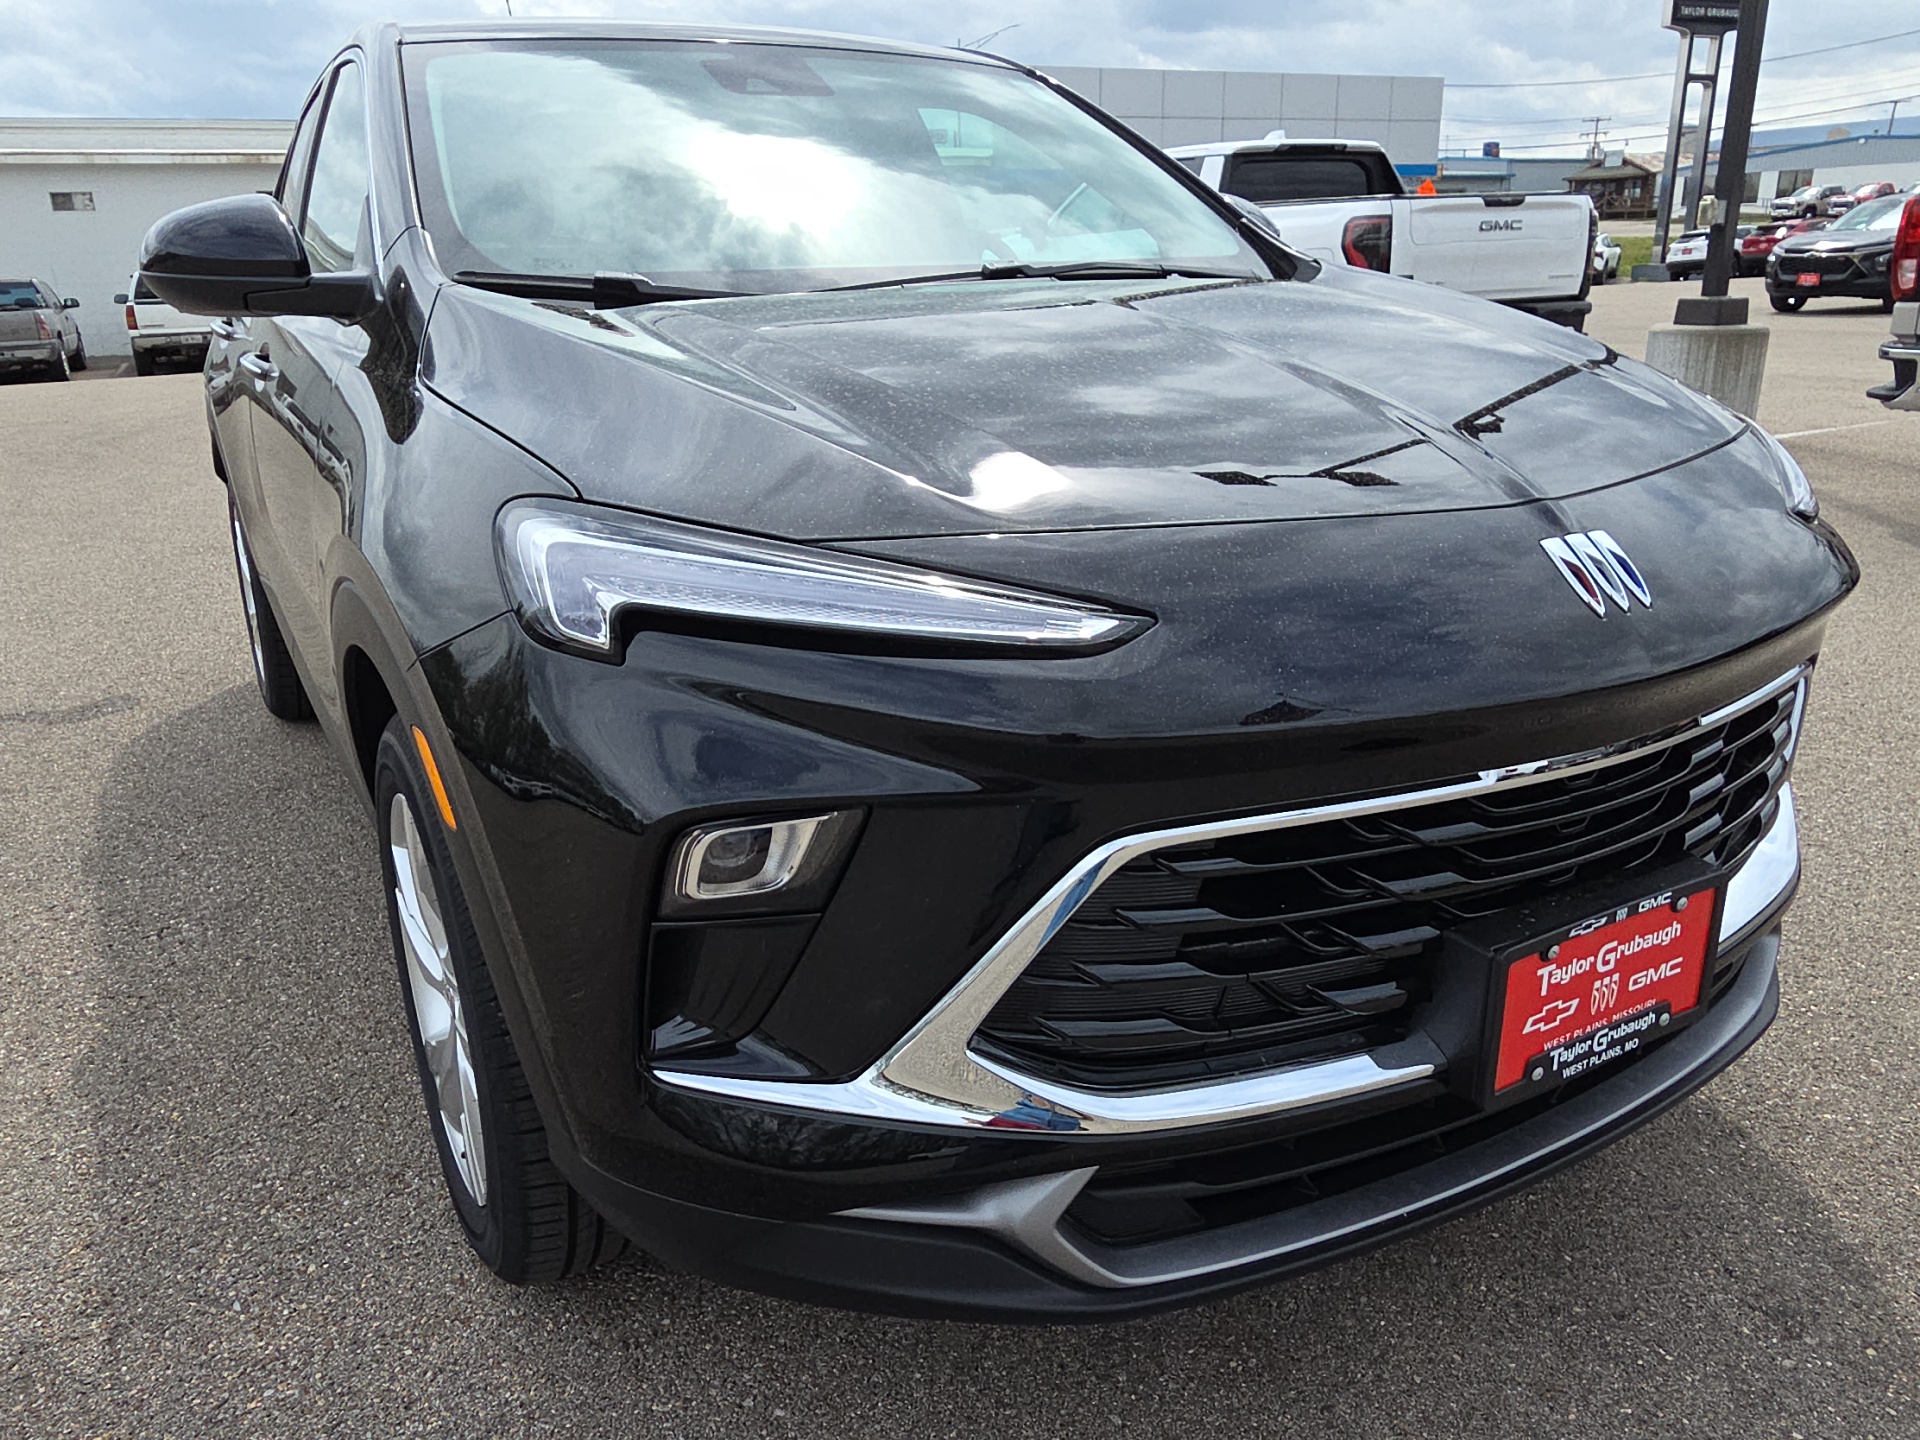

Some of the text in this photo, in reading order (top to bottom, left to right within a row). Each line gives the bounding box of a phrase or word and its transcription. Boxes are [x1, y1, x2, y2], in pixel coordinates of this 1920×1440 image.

[1707, 7, 1739, 17] GRUBAUG
[1479, 219, 1524, 232] GMC
[1638, 891, 1673, 913] GMC
[1536, 920, 1682, 997] Taylor Grubaugh
[1628, 956, 1684, 992] GMC
[1543, 1033, 1572, 1051] WEST
[1611, 998, 1657, 1023] MISSOURI
[1549, 1011, 1656, 1072] Taylor Grubaugh
[1562, 1037, 1640, 1079] WEST PLAINS, MO
